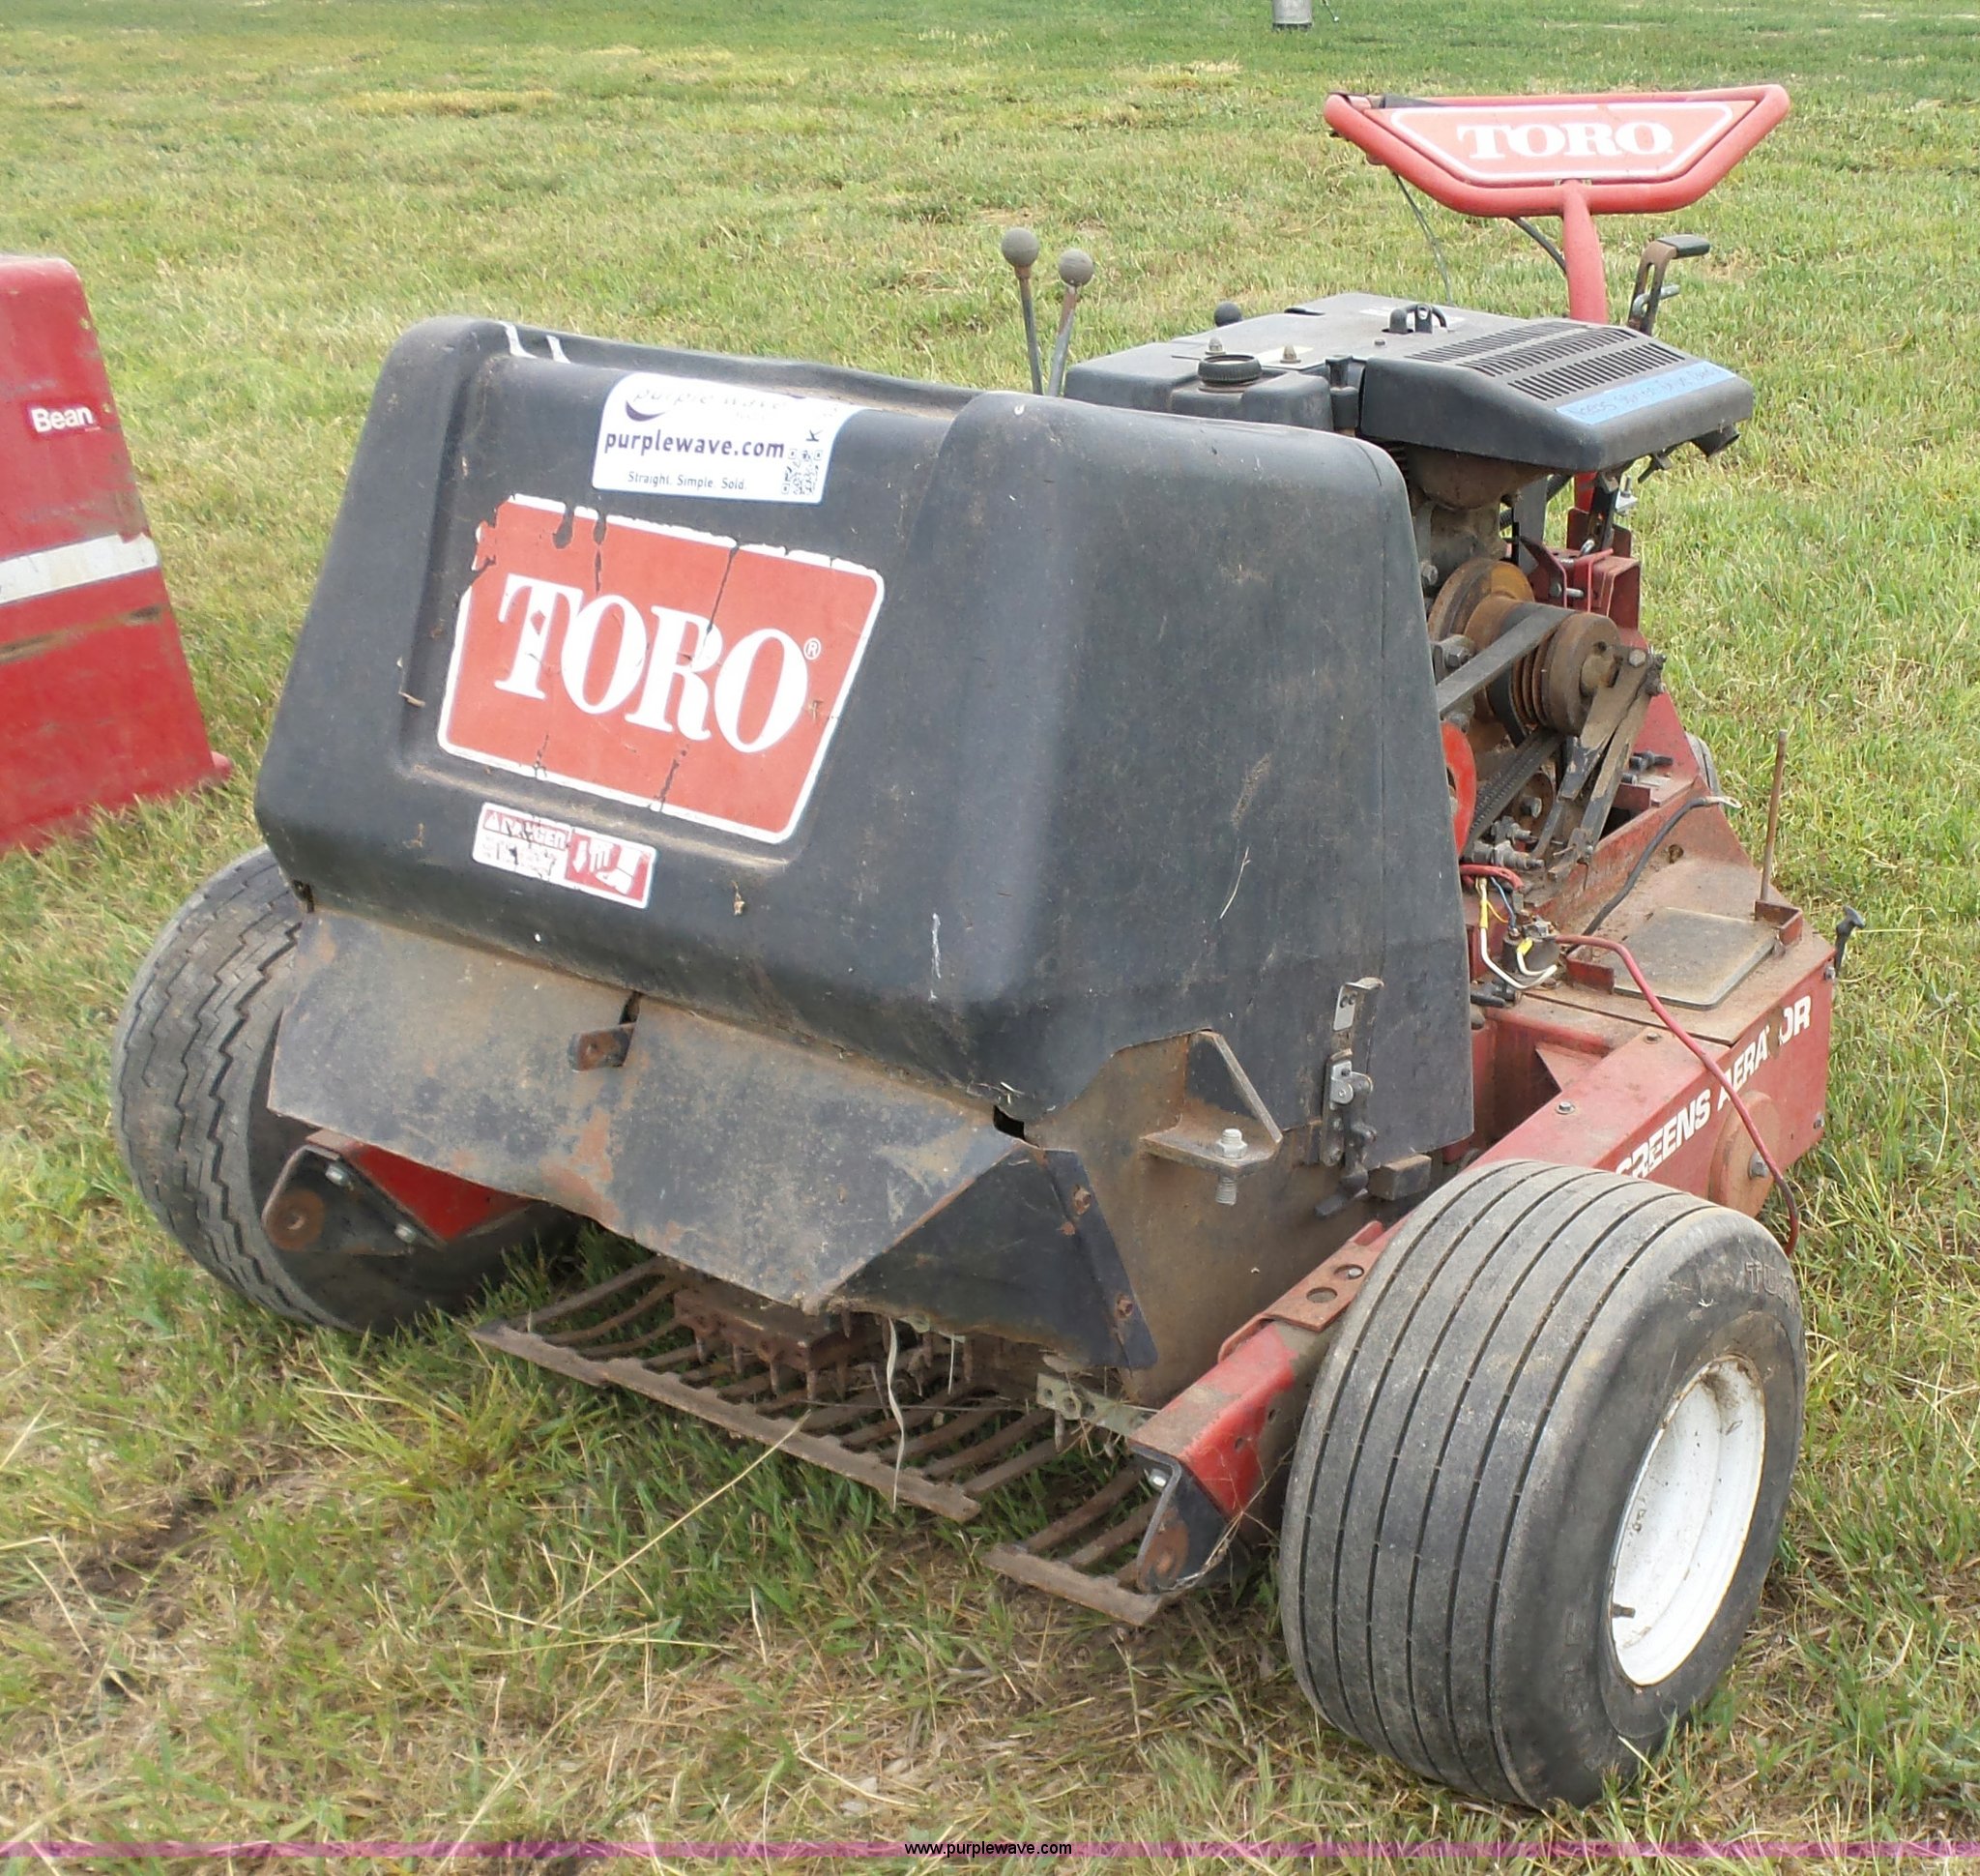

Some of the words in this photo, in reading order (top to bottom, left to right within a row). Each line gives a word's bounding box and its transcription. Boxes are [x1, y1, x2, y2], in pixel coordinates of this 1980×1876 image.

[1456, 120, 1674, 161] TORO
[31, 406, 95, 433] Bean
[604, 429, 785, 458] purplewave.com
[494, 572, 809, 754] TORO
[1717, 995, 1812, 1112] AERAOR
